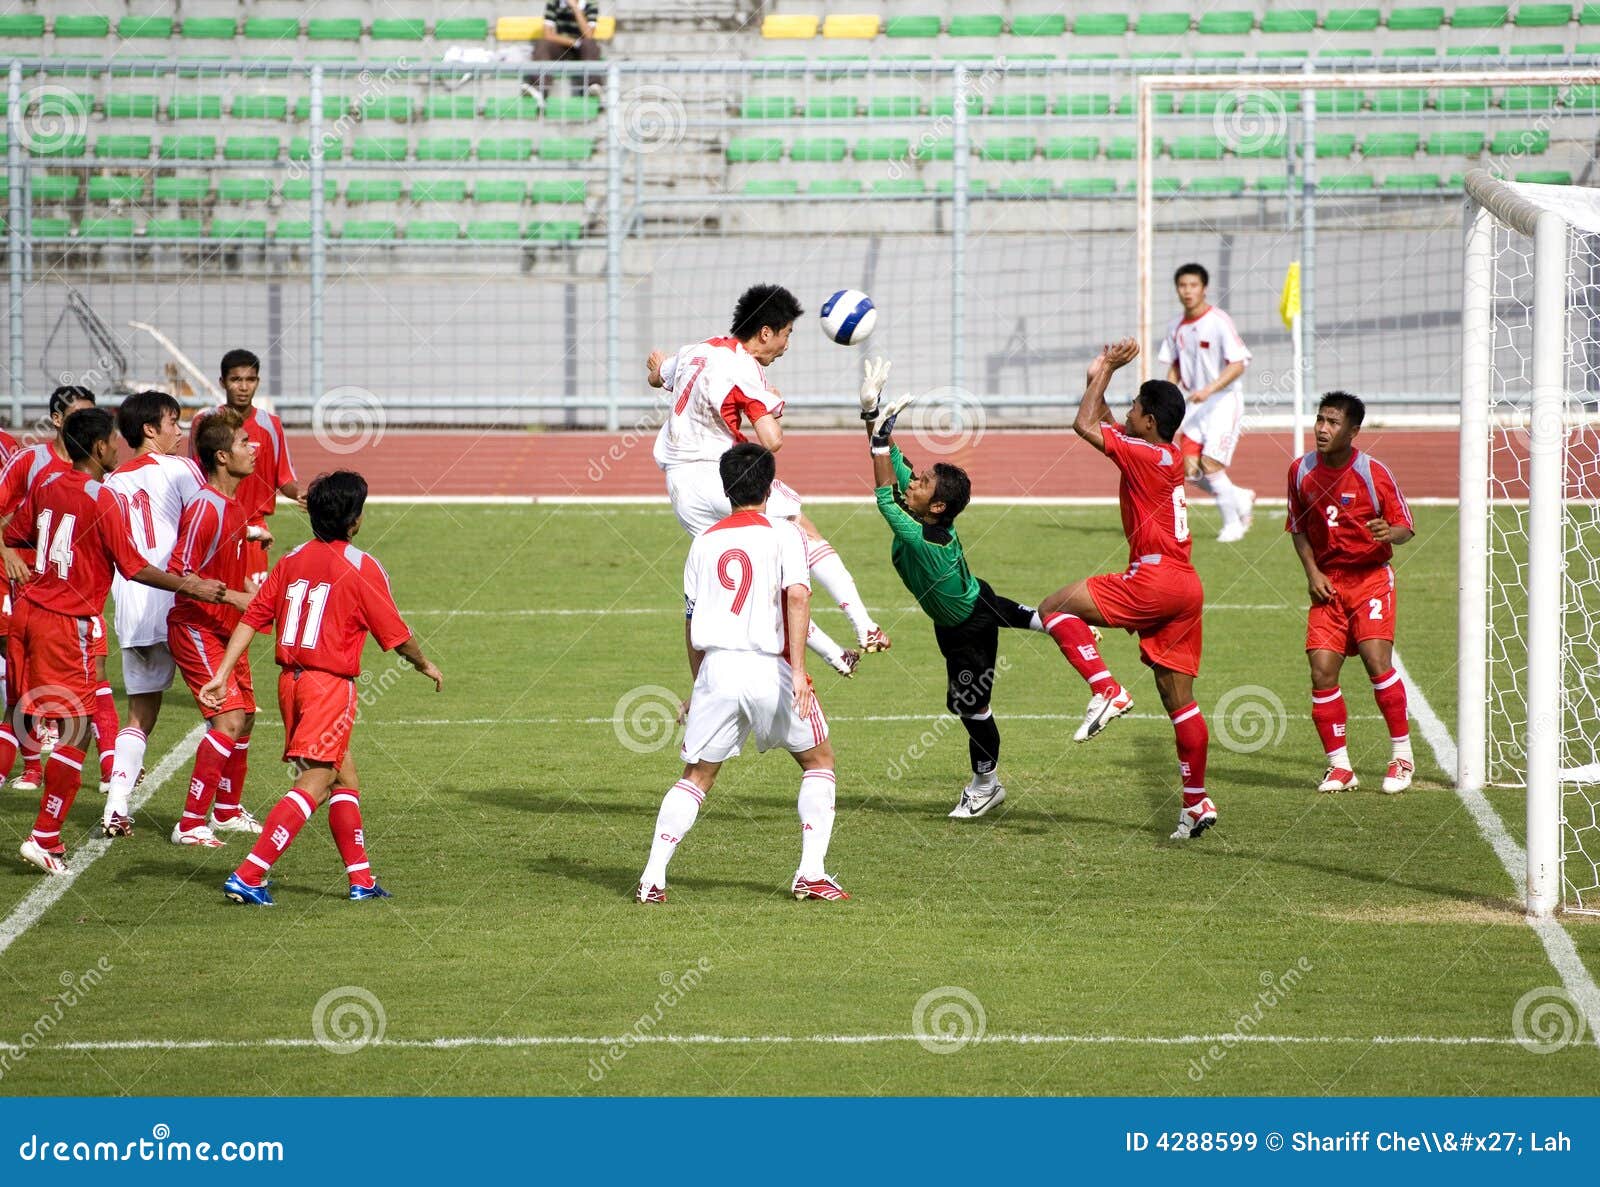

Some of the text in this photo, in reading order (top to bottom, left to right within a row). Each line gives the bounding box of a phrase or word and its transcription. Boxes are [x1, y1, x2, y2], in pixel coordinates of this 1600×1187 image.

[674, 356, 708, 417] 7
[36, 508, 76, 580] 14
[1326, 505, 1339, 527] 2
[281, 578, 331, 650] 11
[717, 549, 754, 616] 9
[1369, 598, 1383, 620] 2
